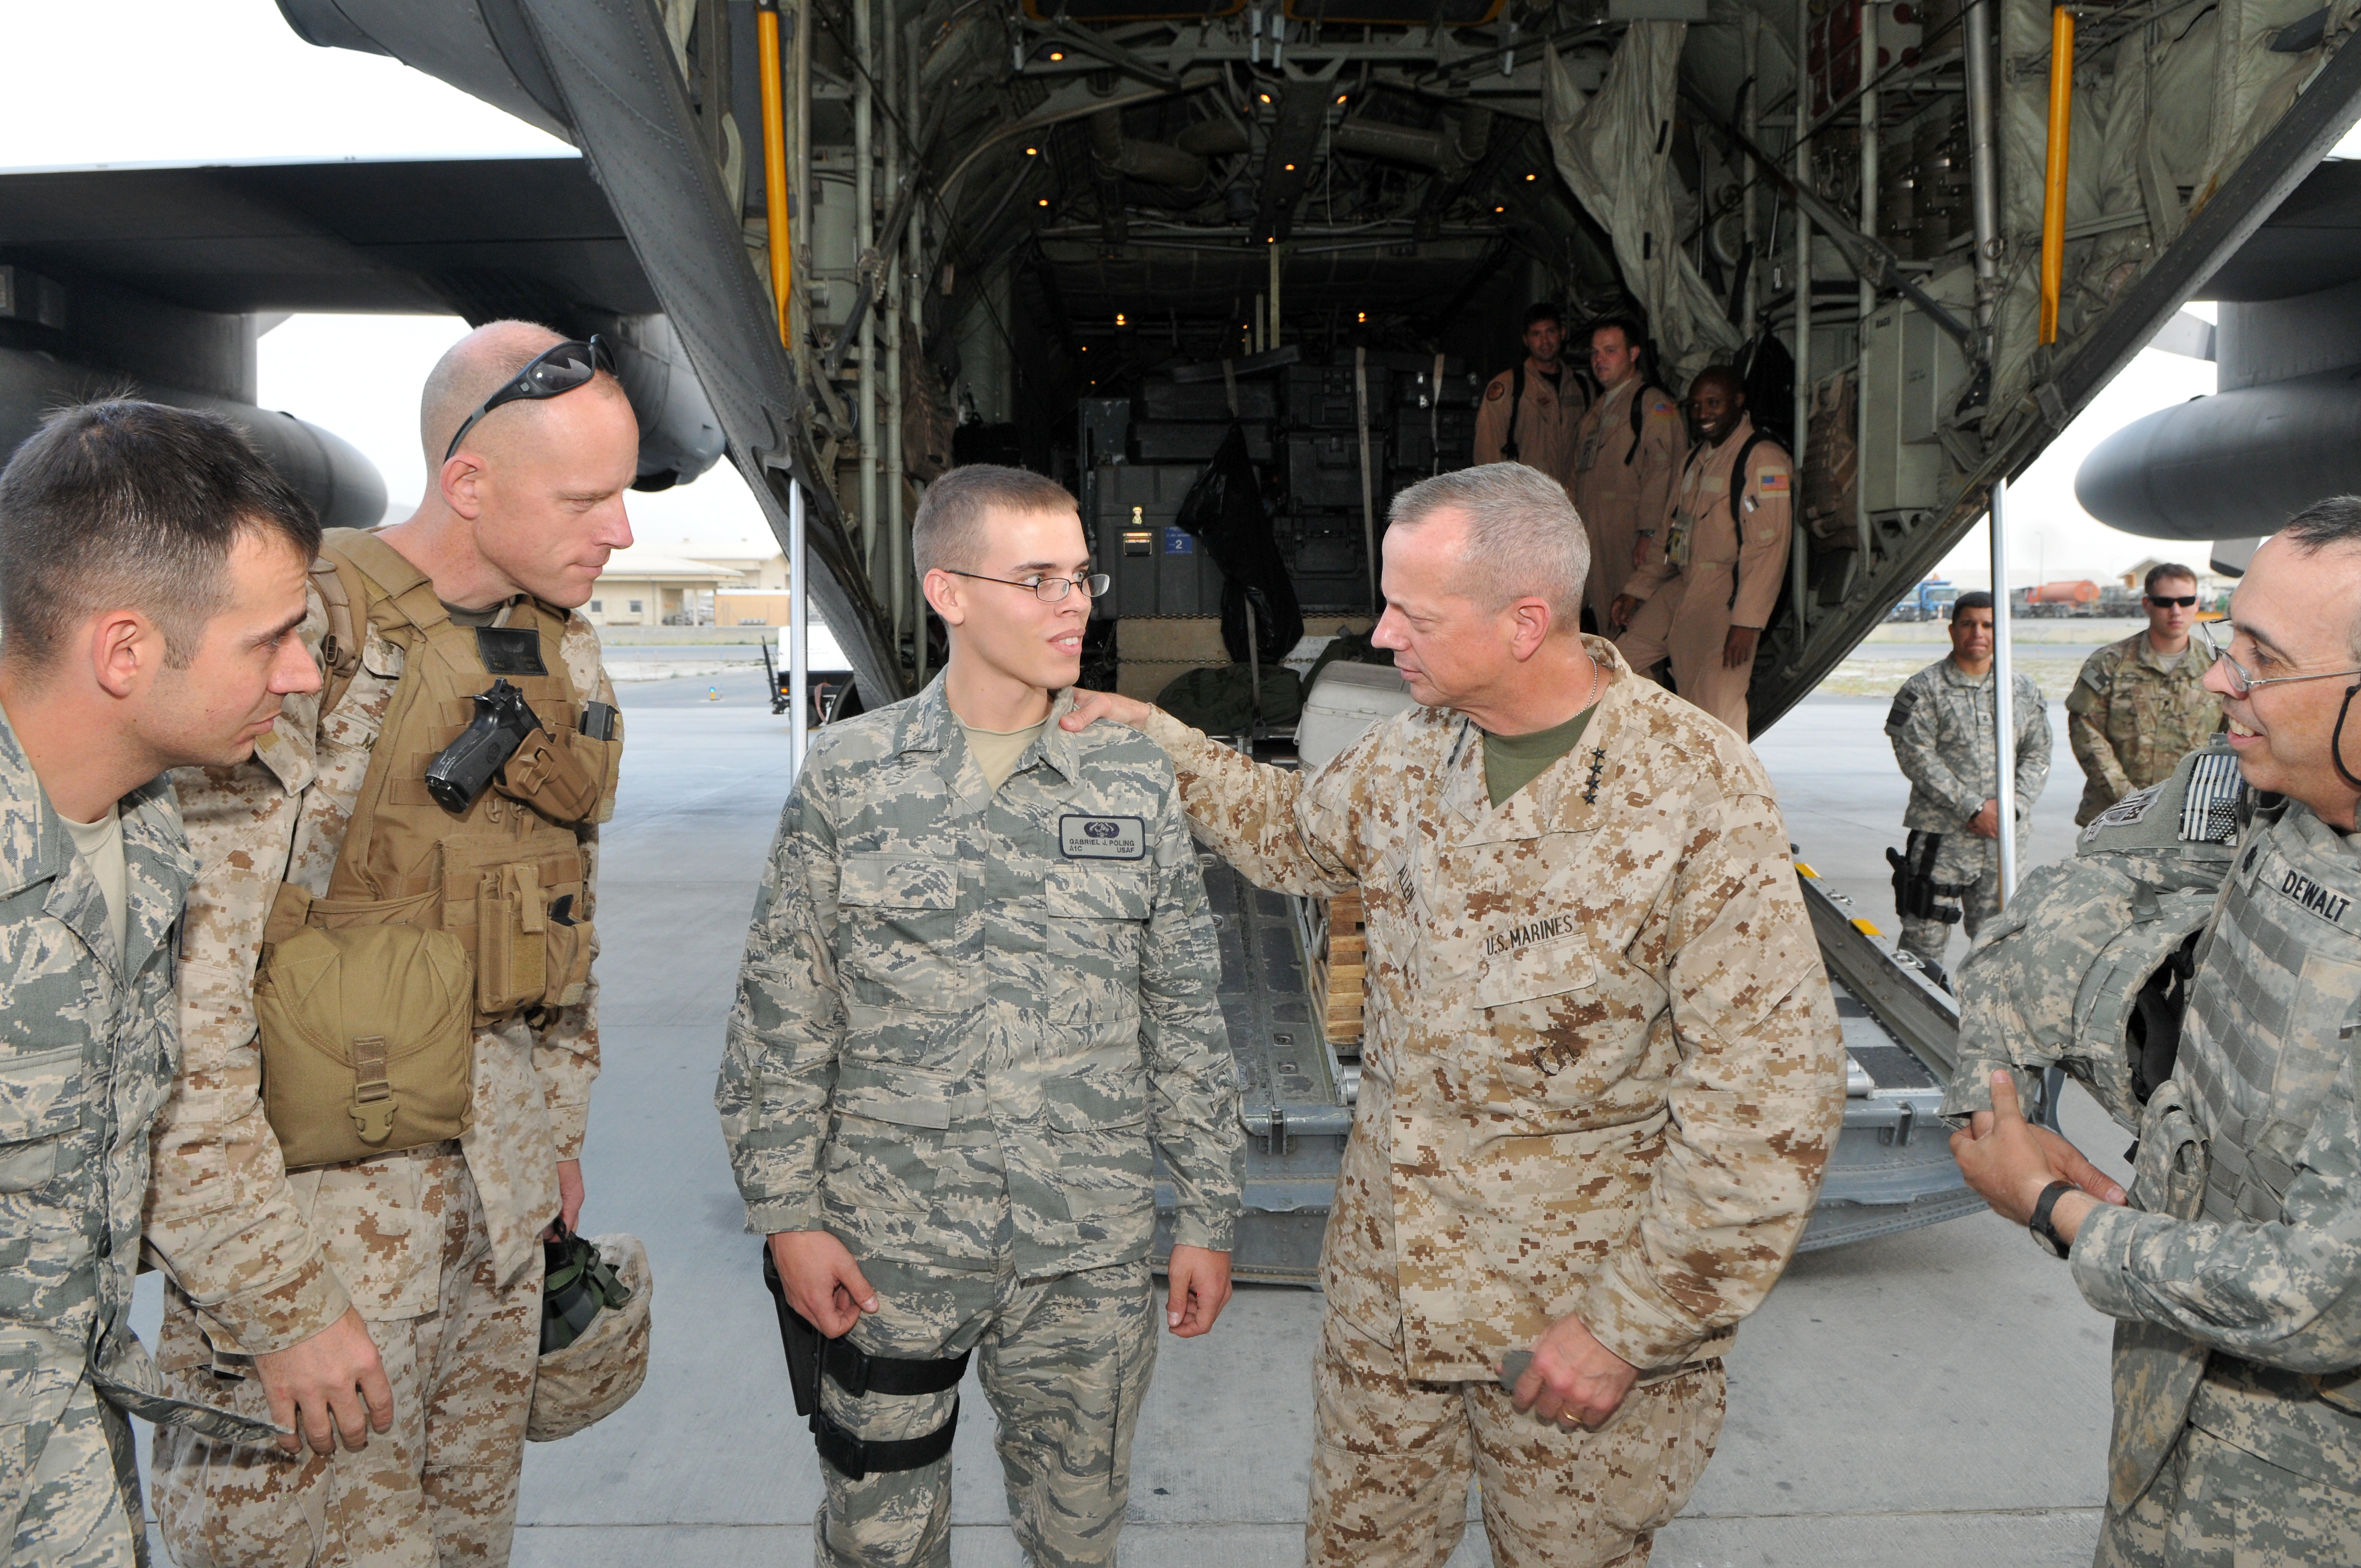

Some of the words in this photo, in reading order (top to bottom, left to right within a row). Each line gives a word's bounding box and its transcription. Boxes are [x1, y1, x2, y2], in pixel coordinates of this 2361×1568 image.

[1175, 539, 1183, 549] 2
[1397, 863, 1416, 905] ALLEN
[2281, 870, 2351, 923] DEWALT
[1487, 934, 1508, 955] U.S.
[1509, 914, 1573, 948] MARINES
